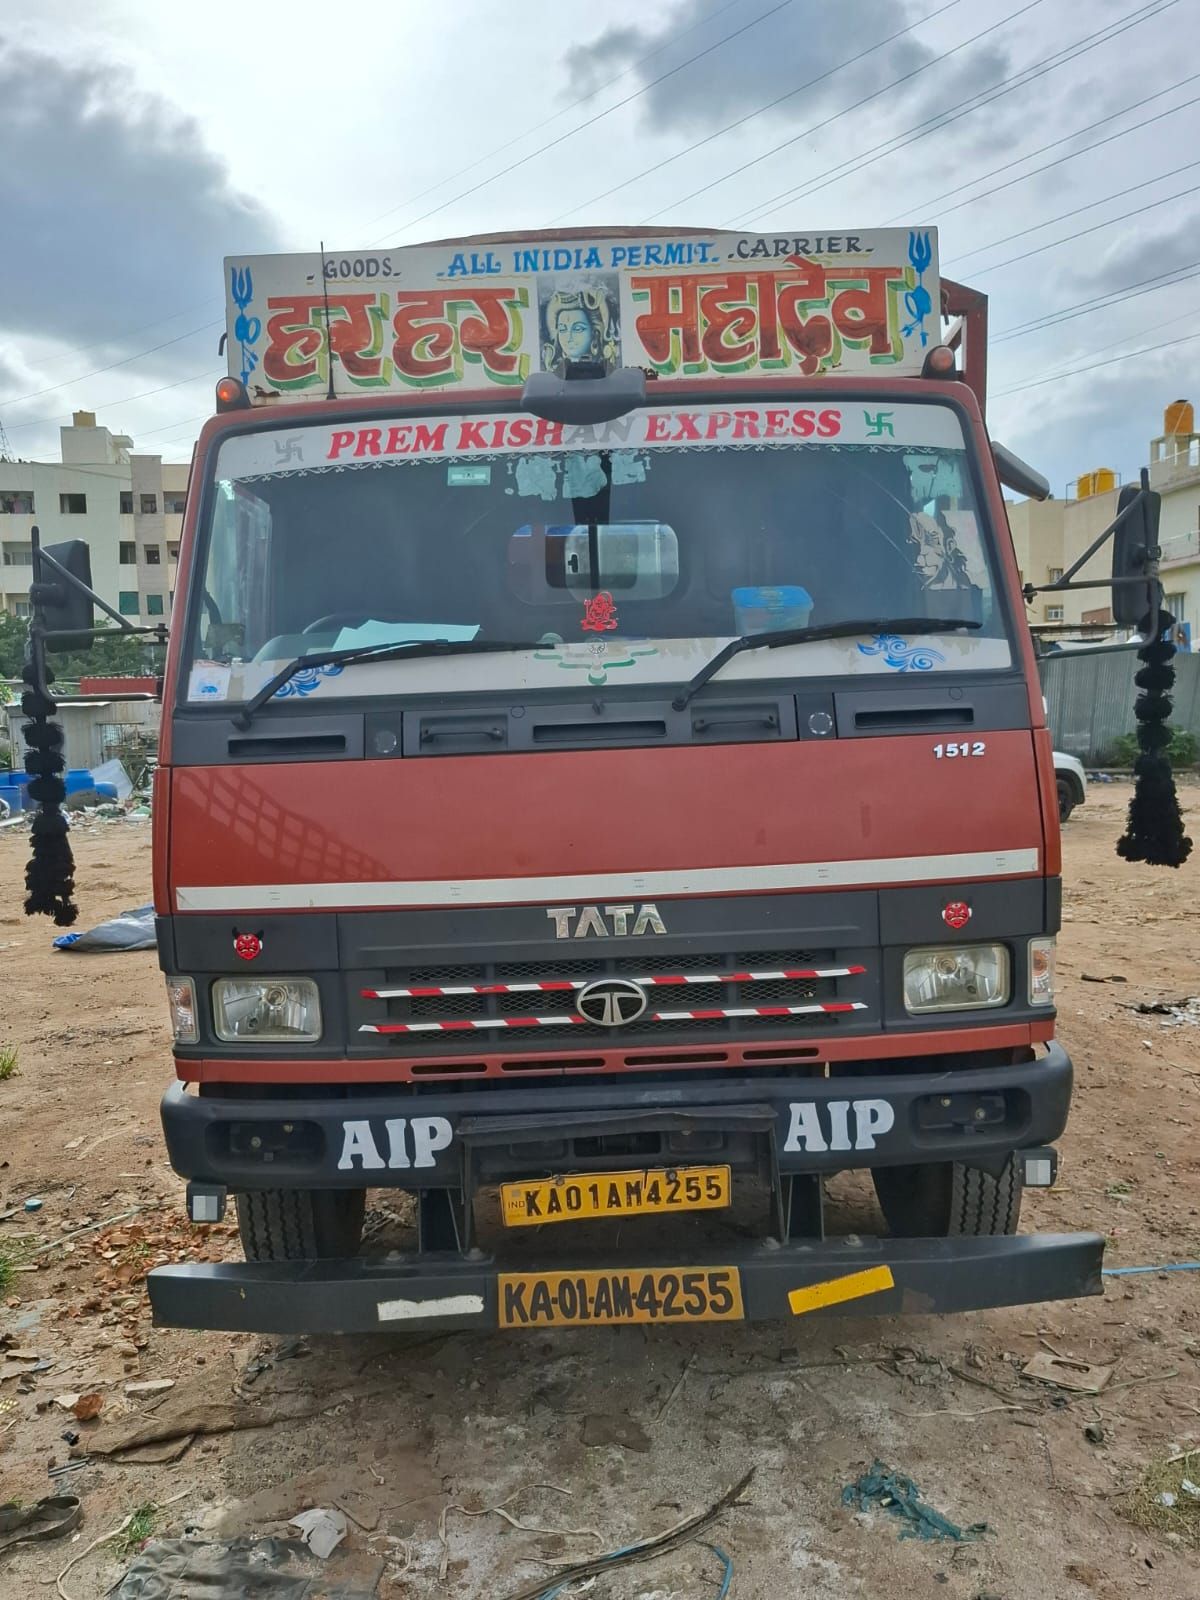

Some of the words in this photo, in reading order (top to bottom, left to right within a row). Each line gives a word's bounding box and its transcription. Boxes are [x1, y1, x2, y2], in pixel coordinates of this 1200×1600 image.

[448, 252, 501, 276] ALL
[513, 246, 603, 272] INIDIA
[263, 293, 388, 382] हर
[392, 287, 520, 377] हर
[630, 255, 903, 377] महादेव
[326, 423, 449, 460] PREM
[456, 415, 635, 449] KISHAN
[643, 409, 843, 443] EXPRESS
[933, 742, 986, 758] 1512
[546, 903, 668, 939] TATA
[337, 1116, 454, 1170] AIP
[783, 1099, 895, 1152] AIP
[507, 1200, 525, 1208] IND
[525, 1175, 723, 1217] KA01AM4255
